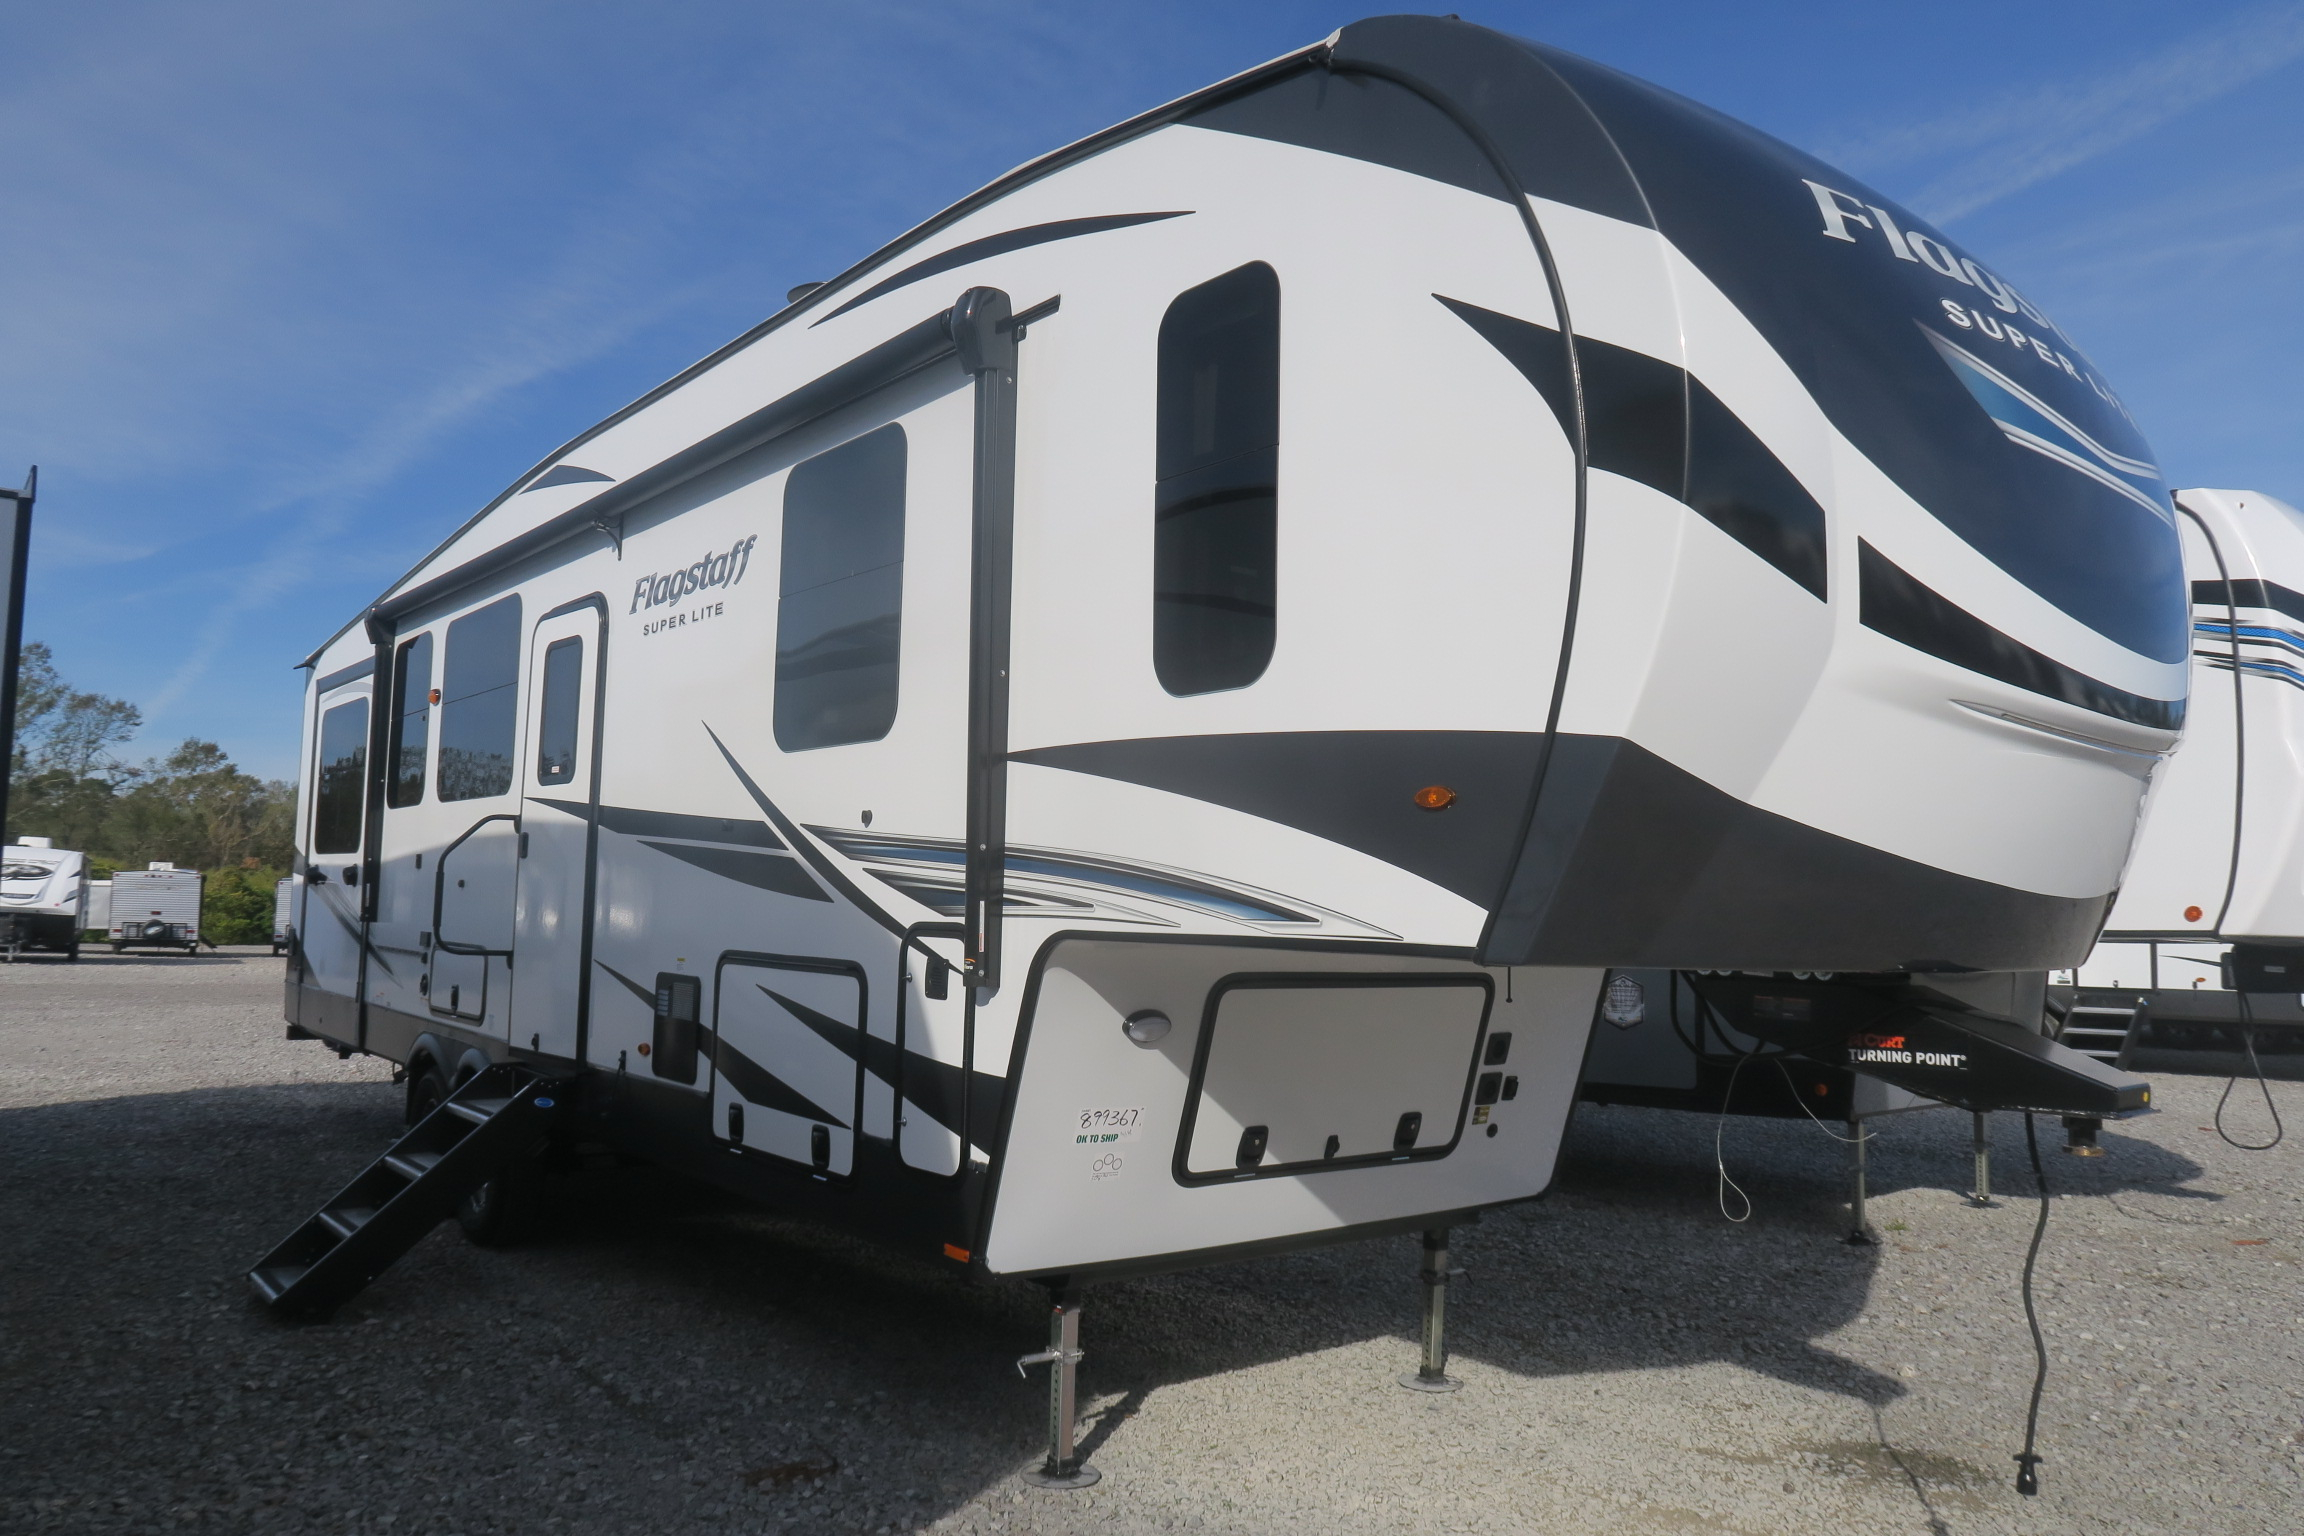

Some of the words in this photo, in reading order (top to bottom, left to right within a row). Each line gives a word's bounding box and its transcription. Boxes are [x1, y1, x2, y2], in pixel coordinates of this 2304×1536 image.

[1940, 298, 2083, 383] SUPER
[628, 533, 758, 615] Flagstaff
[642, 613, 687, 636] SUPER
[691, 602, 724, 623] LITE
[1847, 1048, 1912, 1064] TURNING
[1076, 1134, 1088, 1144] OK
[1089, 1134, 1099, 1143] TO
[1100, 1133, 1119, 1143] SHIP
